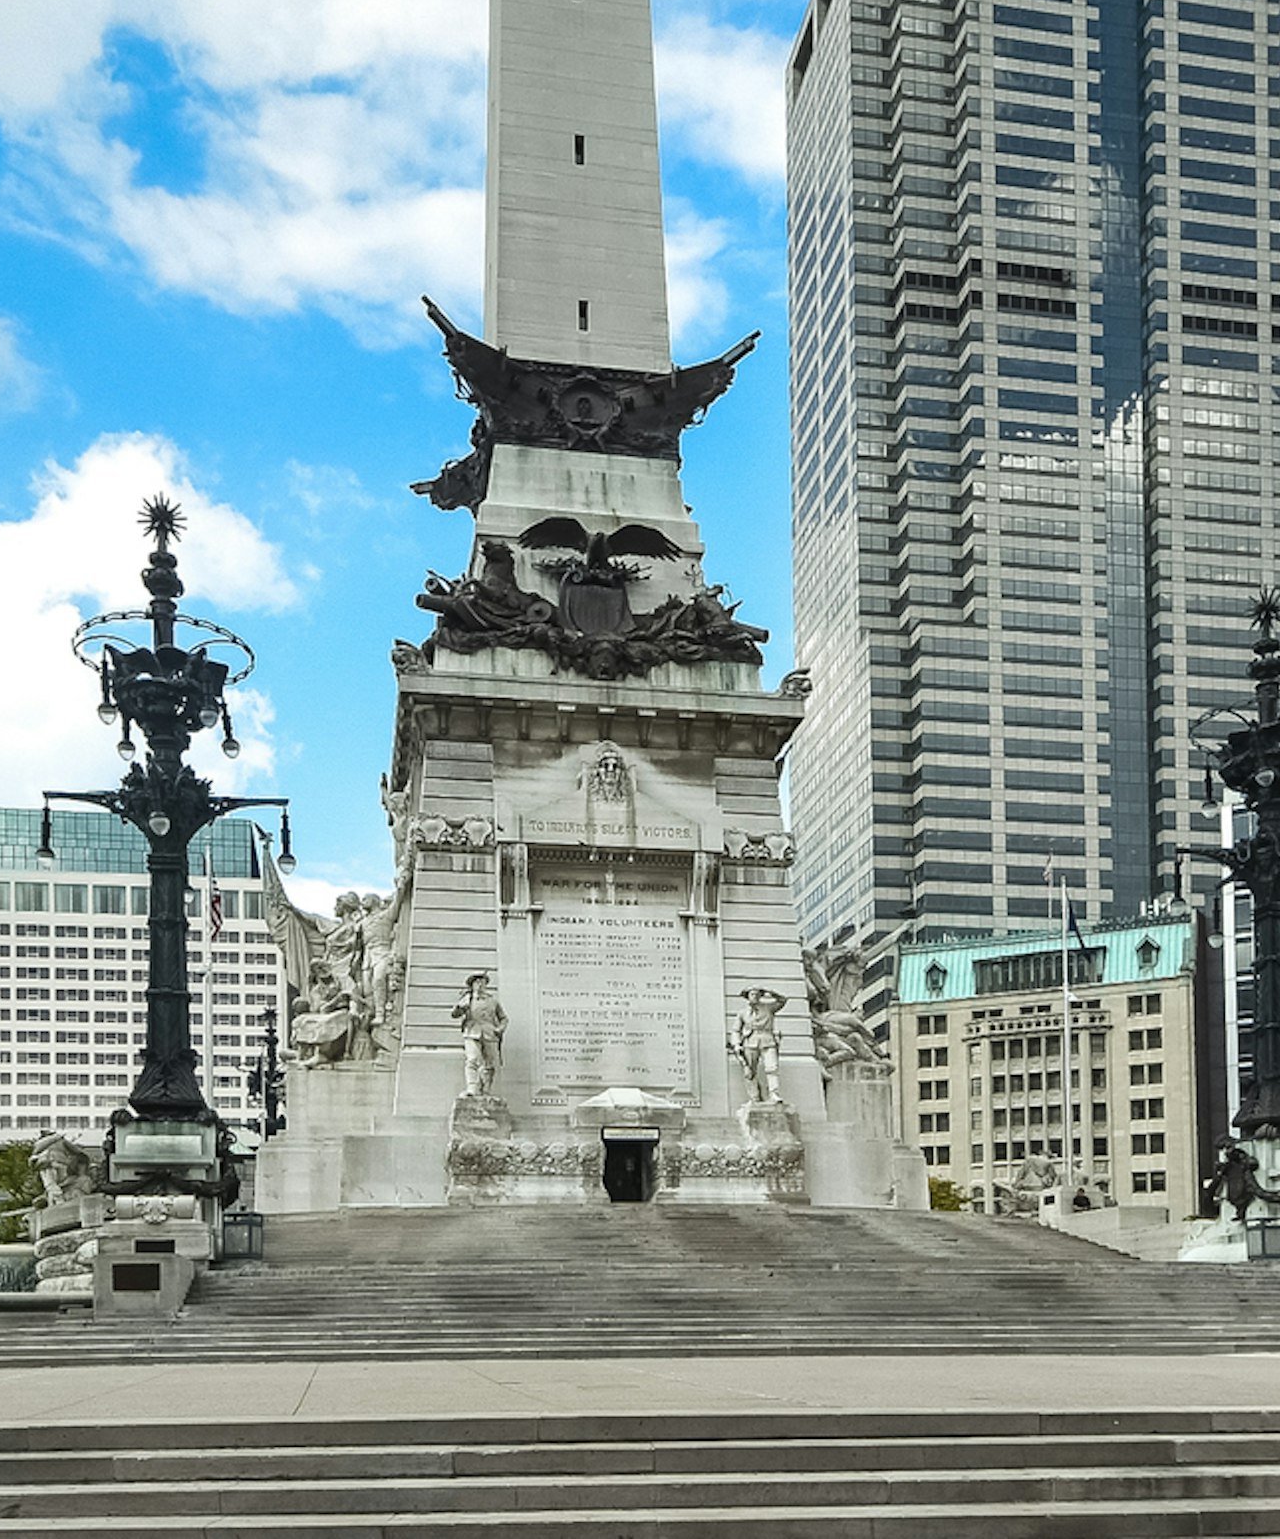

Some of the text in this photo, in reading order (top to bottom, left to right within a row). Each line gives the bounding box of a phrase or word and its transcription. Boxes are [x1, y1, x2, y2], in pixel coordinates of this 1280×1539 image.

[541, 879, 570, 887] WAR
[575, 880, 601, 889] FOR
[637, 883, 679, 892] UNION
[599, 919, 675, 928] VOLUNTEERS
